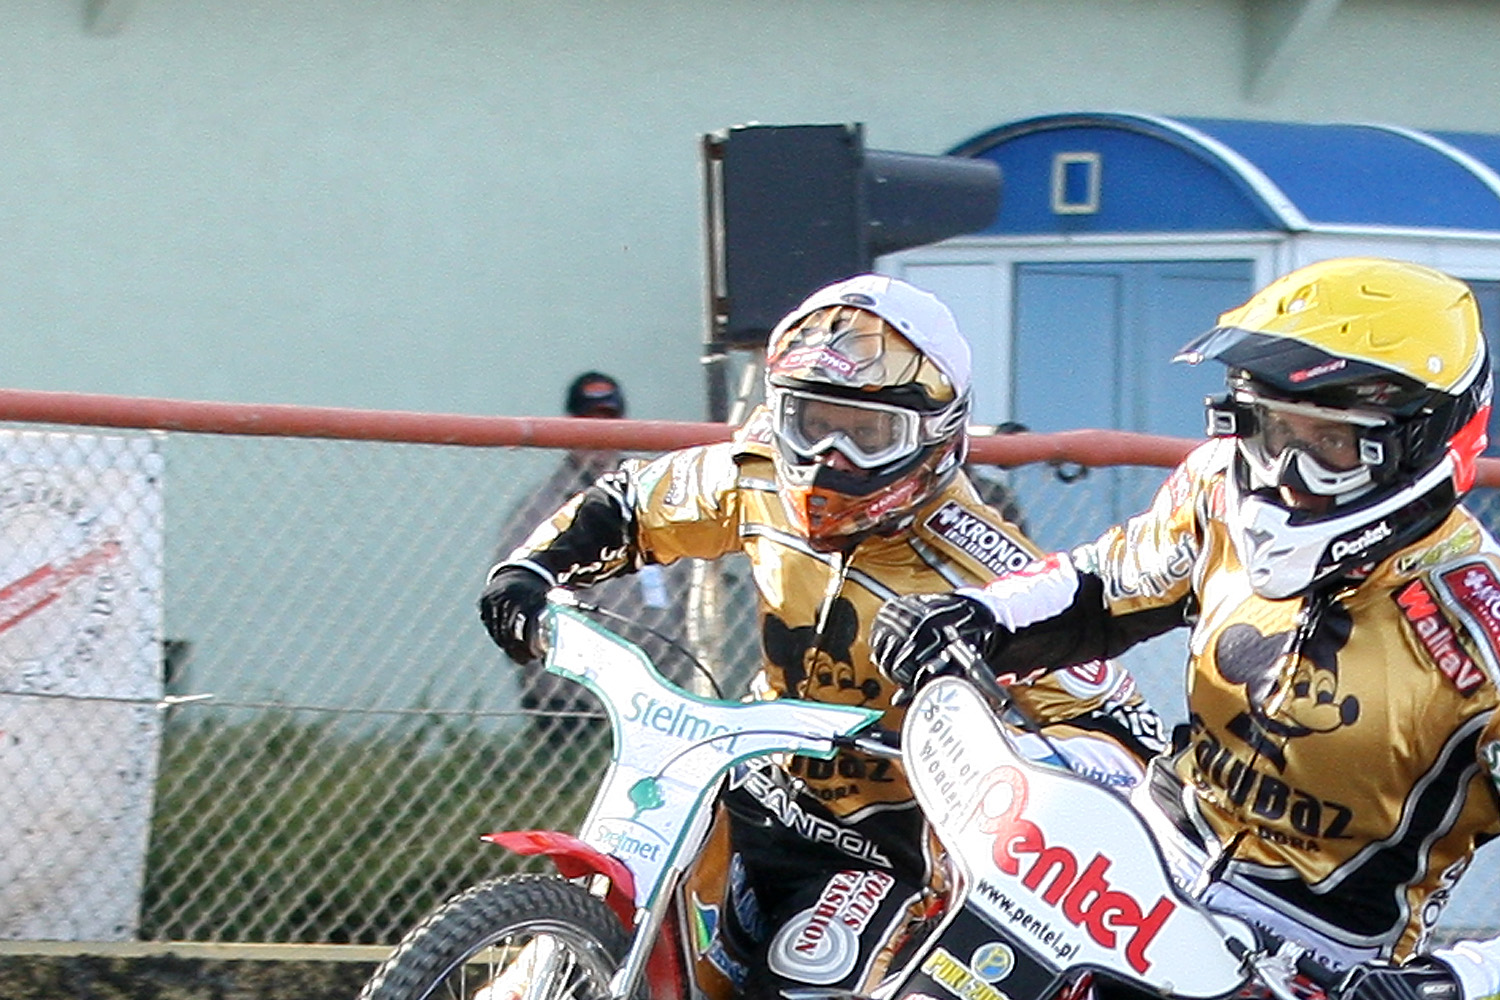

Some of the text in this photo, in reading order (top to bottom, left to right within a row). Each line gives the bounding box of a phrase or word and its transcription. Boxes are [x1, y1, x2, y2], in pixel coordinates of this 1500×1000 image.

[953, 513, 1028, 573] KRONO
[623, 691, 743, 756] Stelmet
[843, 871, 893, 930] FOCUS
[960, 764, 1176, 975] Pentel
[796, 869, 860, 956] FASHION
[976, 877, 1082, 962] www.pentel.pl
